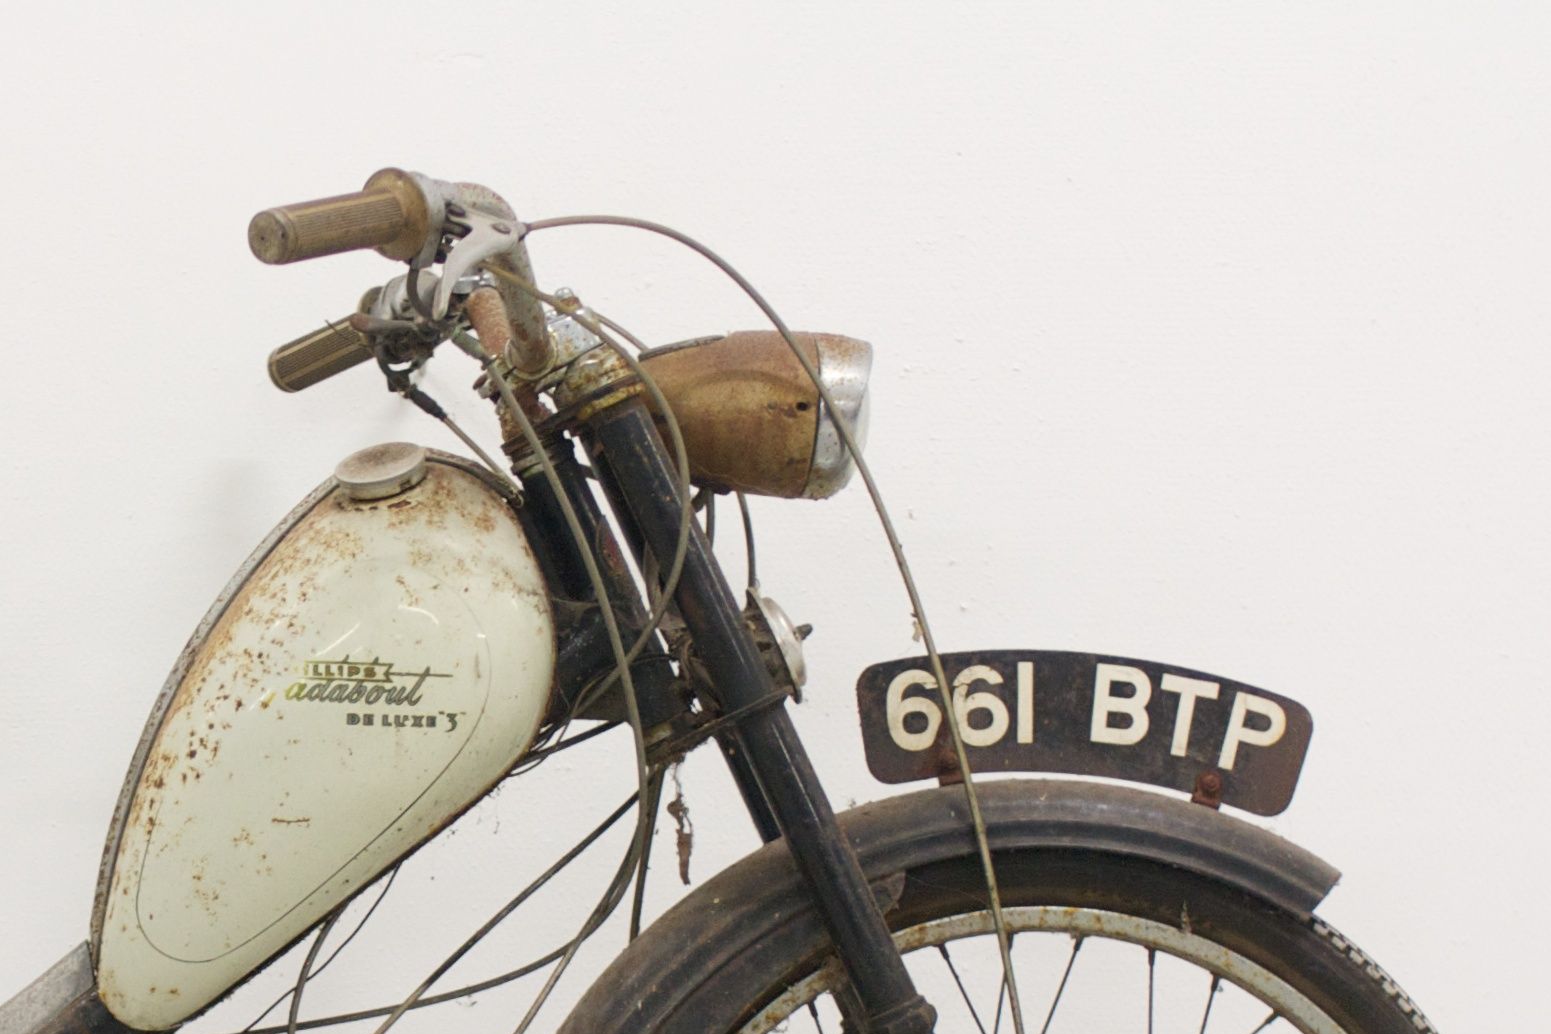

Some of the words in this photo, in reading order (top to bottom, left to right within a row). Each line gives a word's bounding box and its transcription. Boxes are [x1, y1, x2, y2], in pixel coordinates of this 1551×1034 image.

[346, 713, 374, 726] DE
[885, 661, 1034, 752] 661
[1090, 663, 1287, 771] BTP
